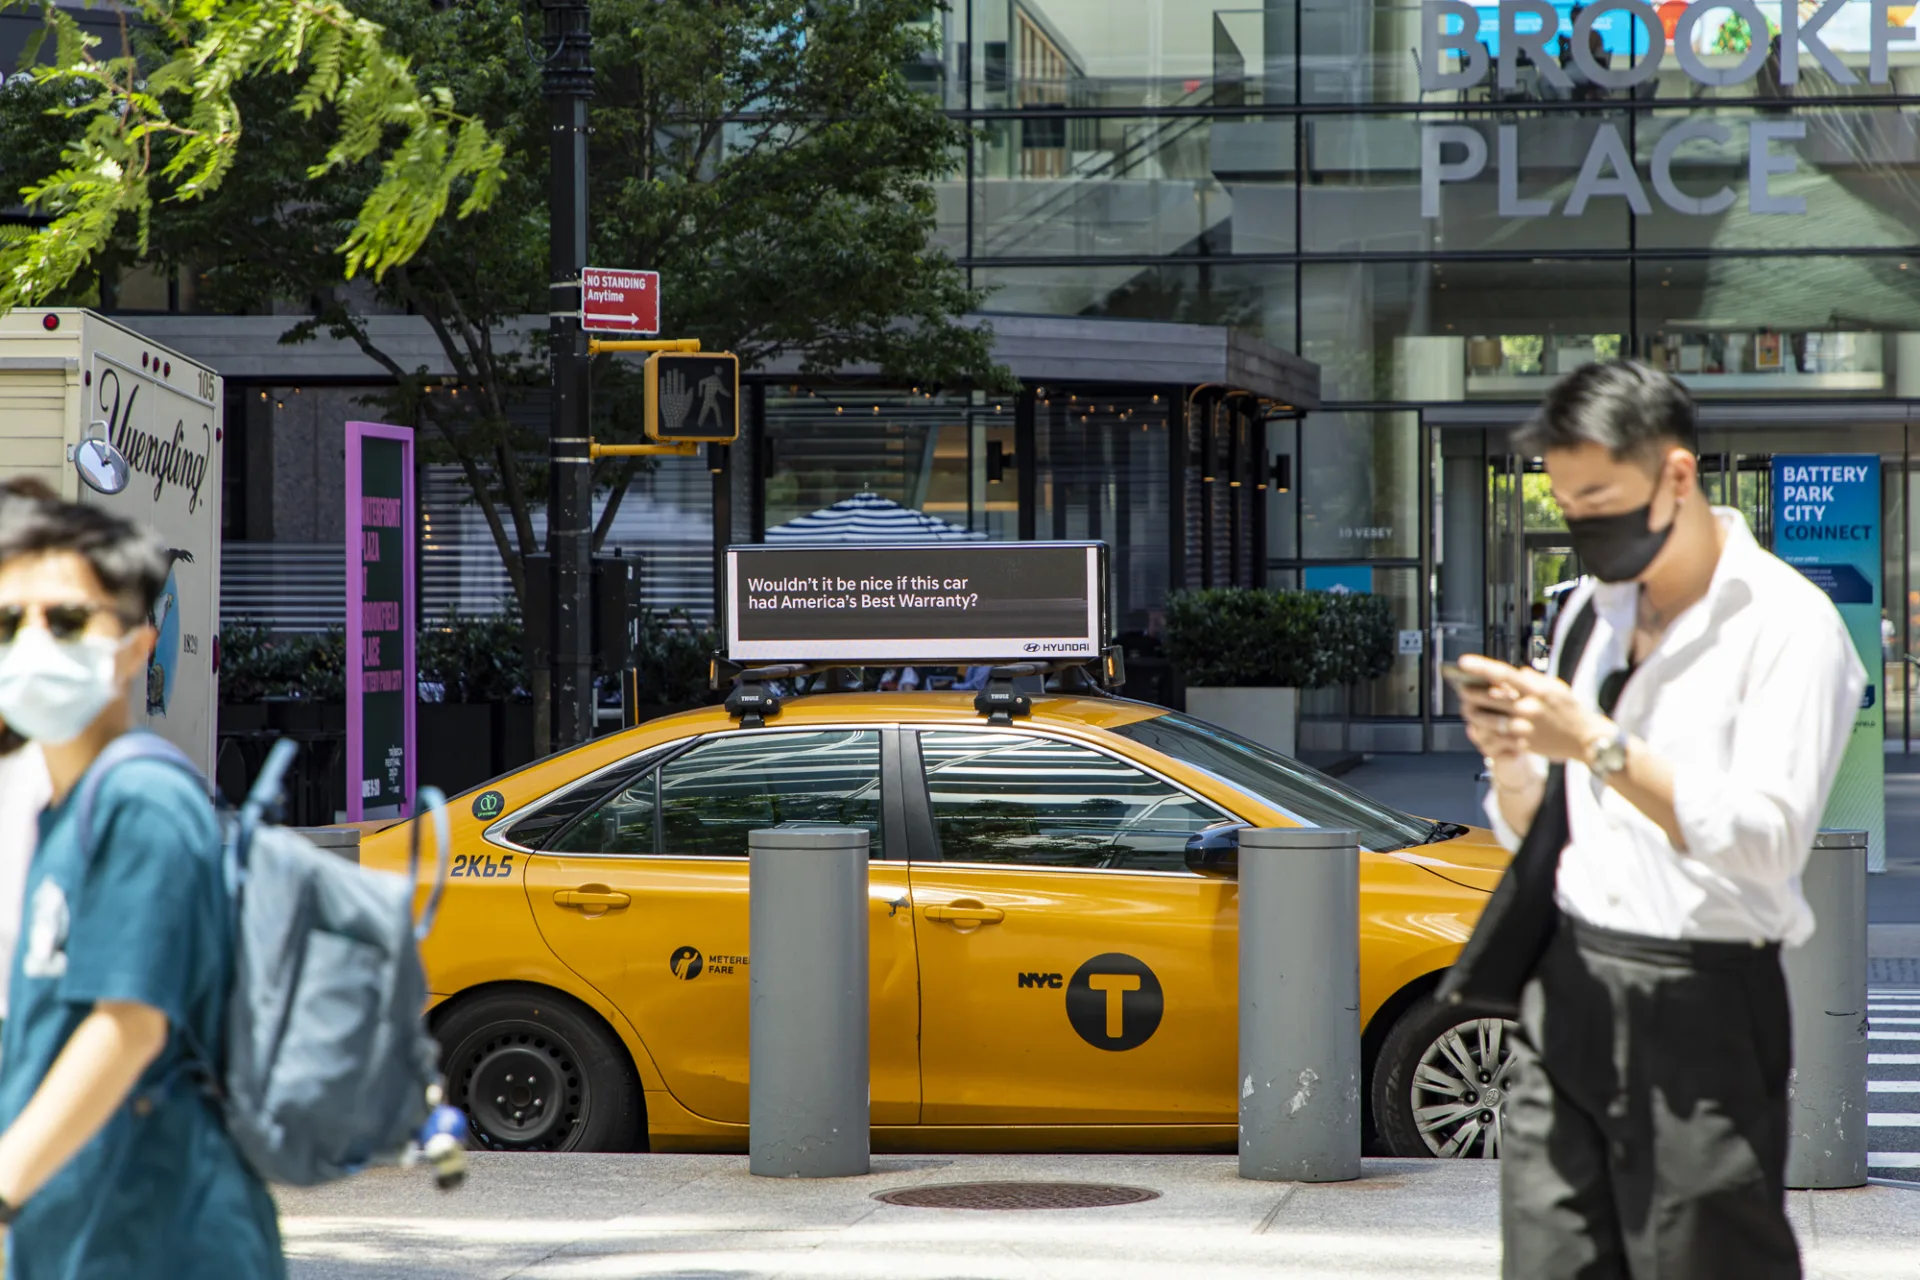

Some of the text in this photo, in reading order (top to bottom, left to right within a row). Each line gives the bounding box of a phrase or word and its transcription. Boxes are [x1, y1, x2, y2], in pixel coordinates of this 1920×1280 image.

[1421, 0, 1920, 88] BROOKF
[1421, 121, 1806, 218] PLACE
[587, 275, 646, 290] NO STANDING
[588, 289, 624, 303] Anytime
[198, 371, 215, 401] 105
[1783, 466, 1868, 482] BATTERY
[1783, 485, 1834, 502] PARK
[1783, 505, 1826, 522] CITY
[1355, 527, 1393, 538] VESEY
[1784, 525, 1872, 540] CONNECT
[822, 577, 833, 591] it
[836, 577, 856, 591] be
[860, 577, 893, 591] nice
[897, 576, 907, 590] if
[910, 576, 939, 590] this
[943, 578, 968, 590] car
[748, 595, 777, 609] had
[861, 594, 895, 608] Best
[899, 593, 978, 610] Warranty?
[1043, 643, 1090, 652] HYUNDAI
[709, 955, 751, 965] METERE
[709, 965, 734, 974] FARE
[1018, 972, 1141, 1039] NYC T
